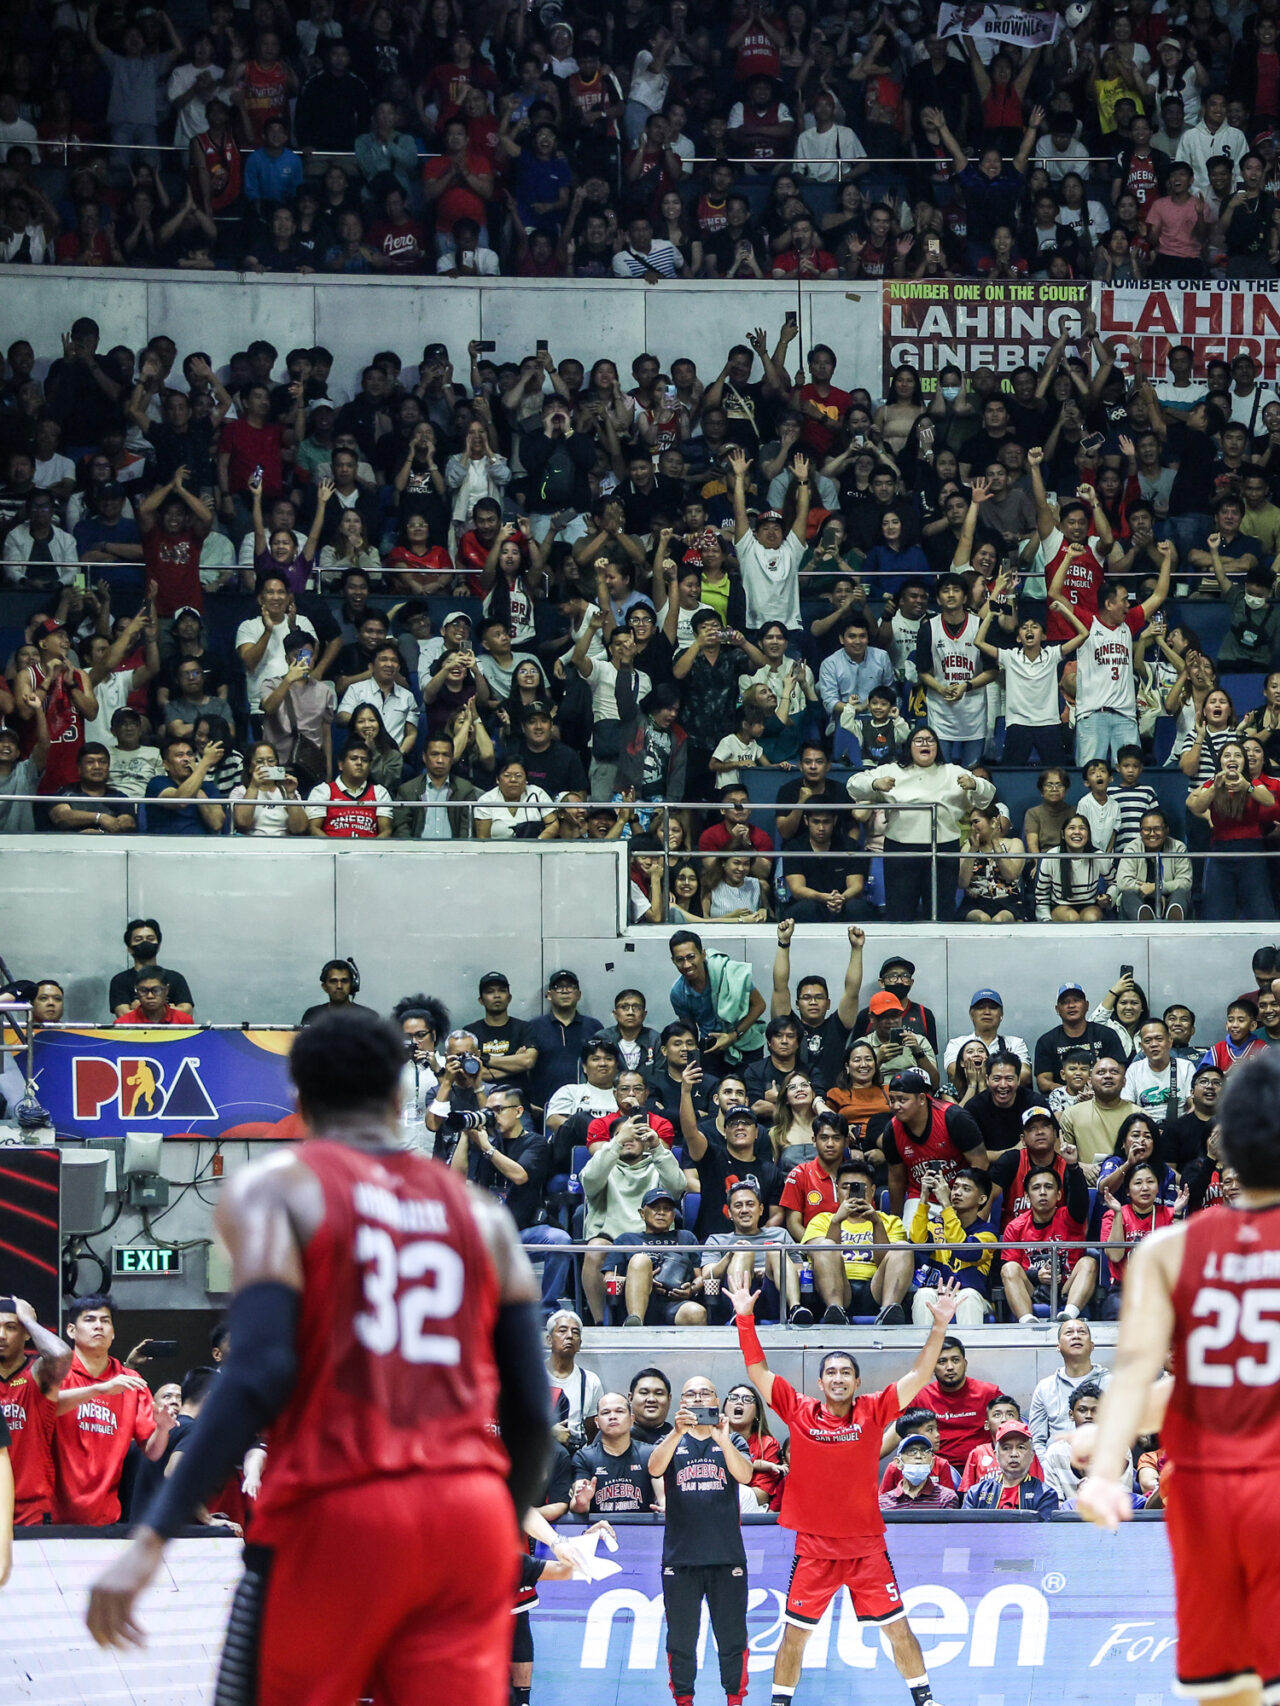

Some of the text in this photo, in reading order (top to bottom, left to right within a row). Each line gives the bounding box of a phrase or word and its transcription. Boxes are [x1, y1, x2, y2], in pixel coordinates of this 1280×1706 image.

[890, 283, 1086, 302] NUMBER ONE ON THE COURT
[1177, 280, 1211, 291] ONE
[1217, 280, 1240, 292] ON
[1248, 280, 1278, 292] THE
[890, 304, 1082, 339] LAHING
[1070, 590, 1078, 604] 5
[1111, 667, 1119, 680] 3
[122, 1250, 172, 1271] EXIT
[354, 1224, 464, 1366] 32
[832, 1431, 859, 1441] MIGUEL
[676, 1463, 728, 1487] GINEBRA
[595, 1484, 643, 1505] GINEBRA
[681, 1479, 725, 1491] SAN MIGUEL
[599, 1498, 640, 1512] SAN MIGUEL
[886, 1583, 898, 1602] 5
